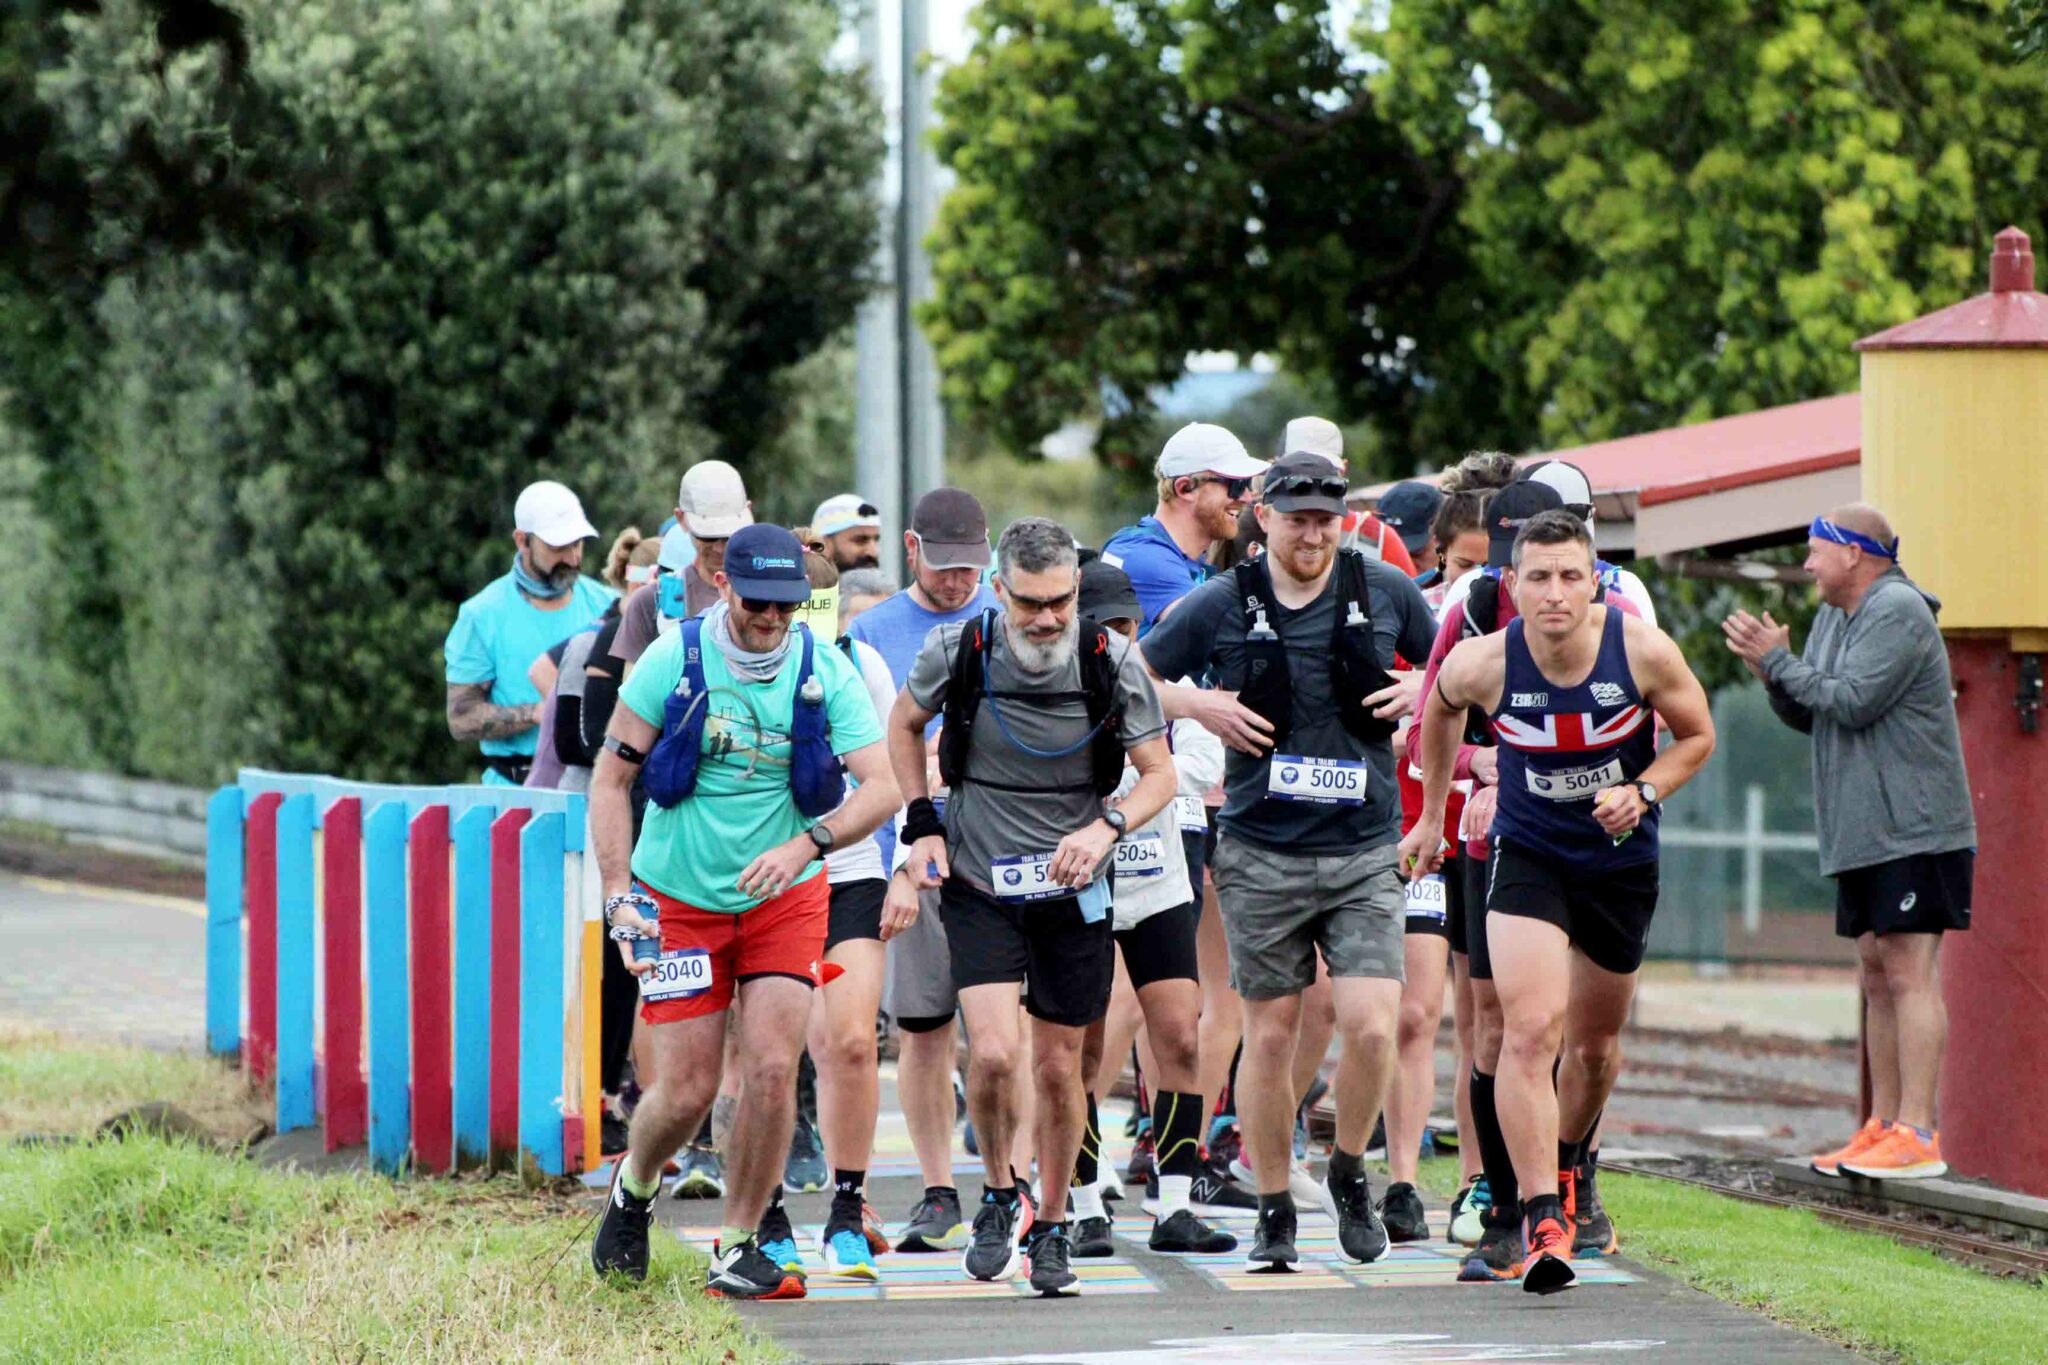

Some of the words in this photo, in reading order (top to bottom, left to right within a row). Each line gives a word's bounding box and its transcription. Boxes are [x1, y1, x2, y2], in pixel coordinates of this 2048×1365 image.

[1303, 756, 1316, 765] TRAIL
[1317, 758, 1338, 767] TRILOGY
[1310, 768, 1357, 790] 5005
[1565, 767, 1611, 790] 5041
[1117, 842, 1158, 862] 5034
[657, 959, 703, 983] 5040
